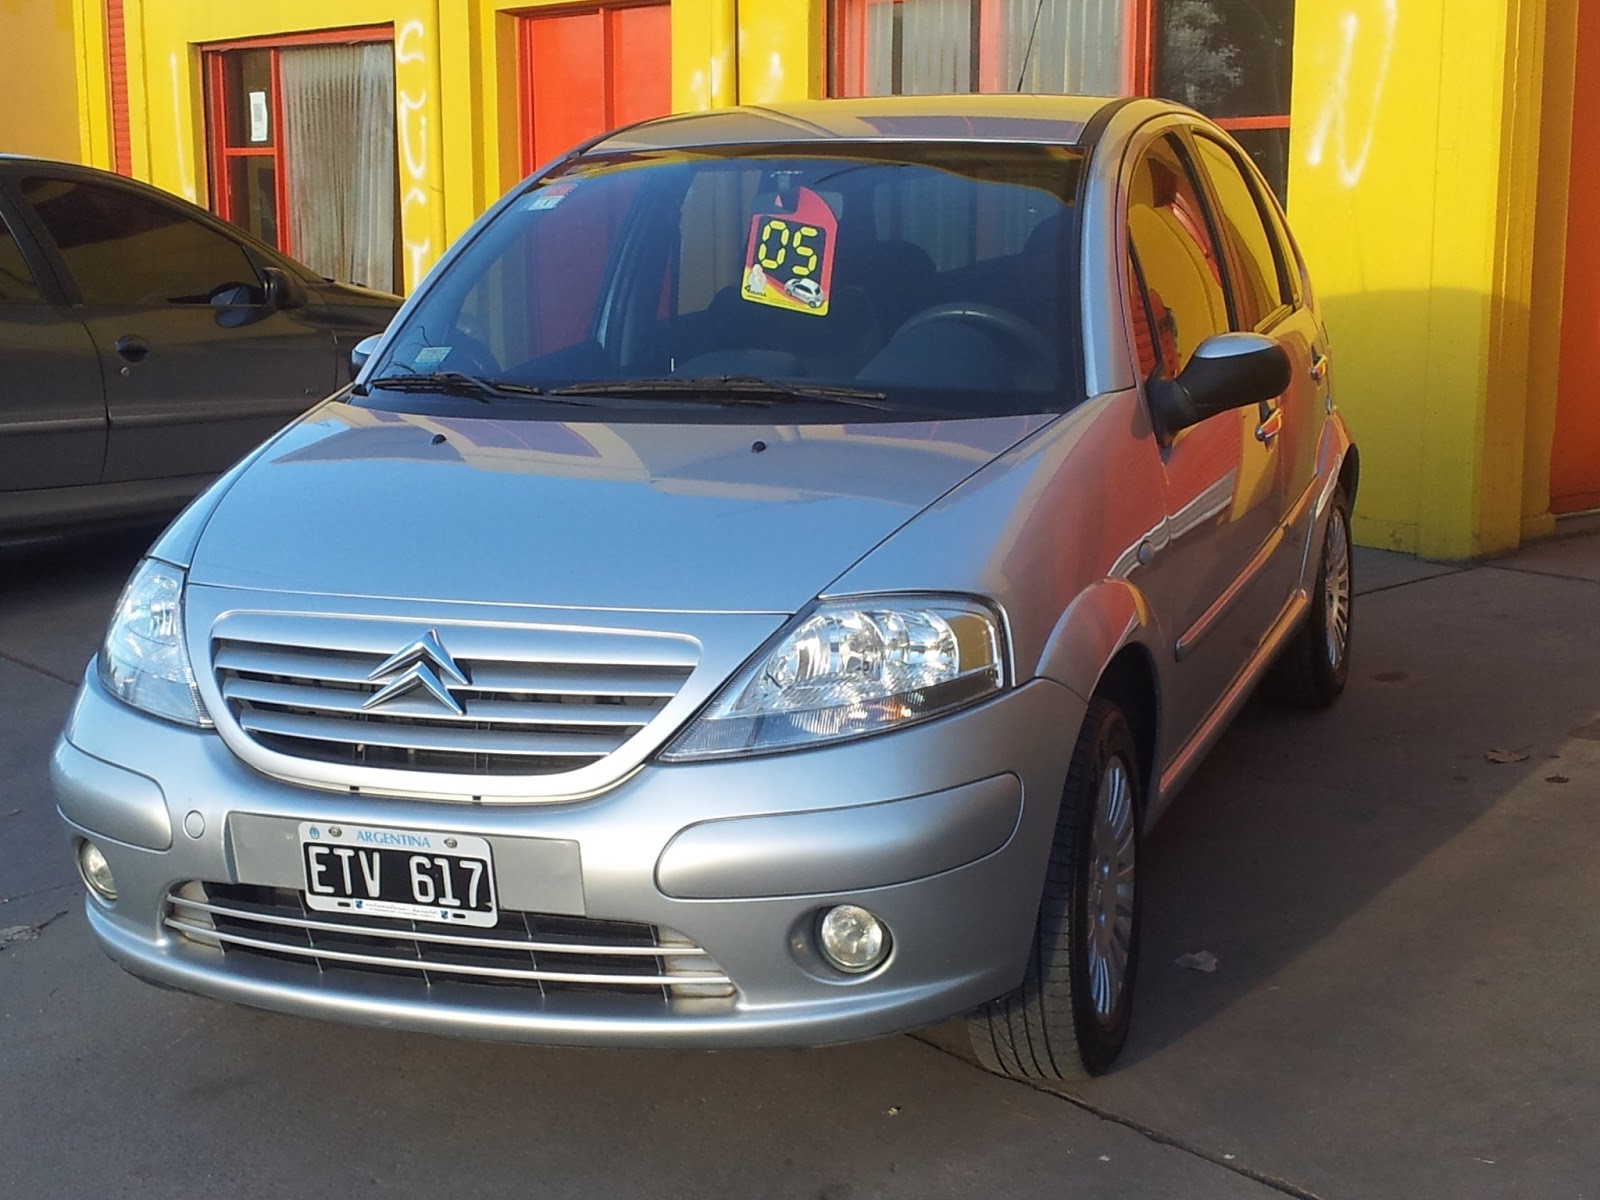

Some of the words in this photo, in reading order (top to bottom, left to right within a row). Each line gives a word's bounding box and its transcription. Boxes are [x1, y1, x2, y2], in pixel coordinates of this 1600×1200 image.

[758, 220, 818, 276] 05
[356, 830, 431, 848] ARGENTINA
[308, 846, 380, 898] ETV
[409, 855, 483, 908] 617
